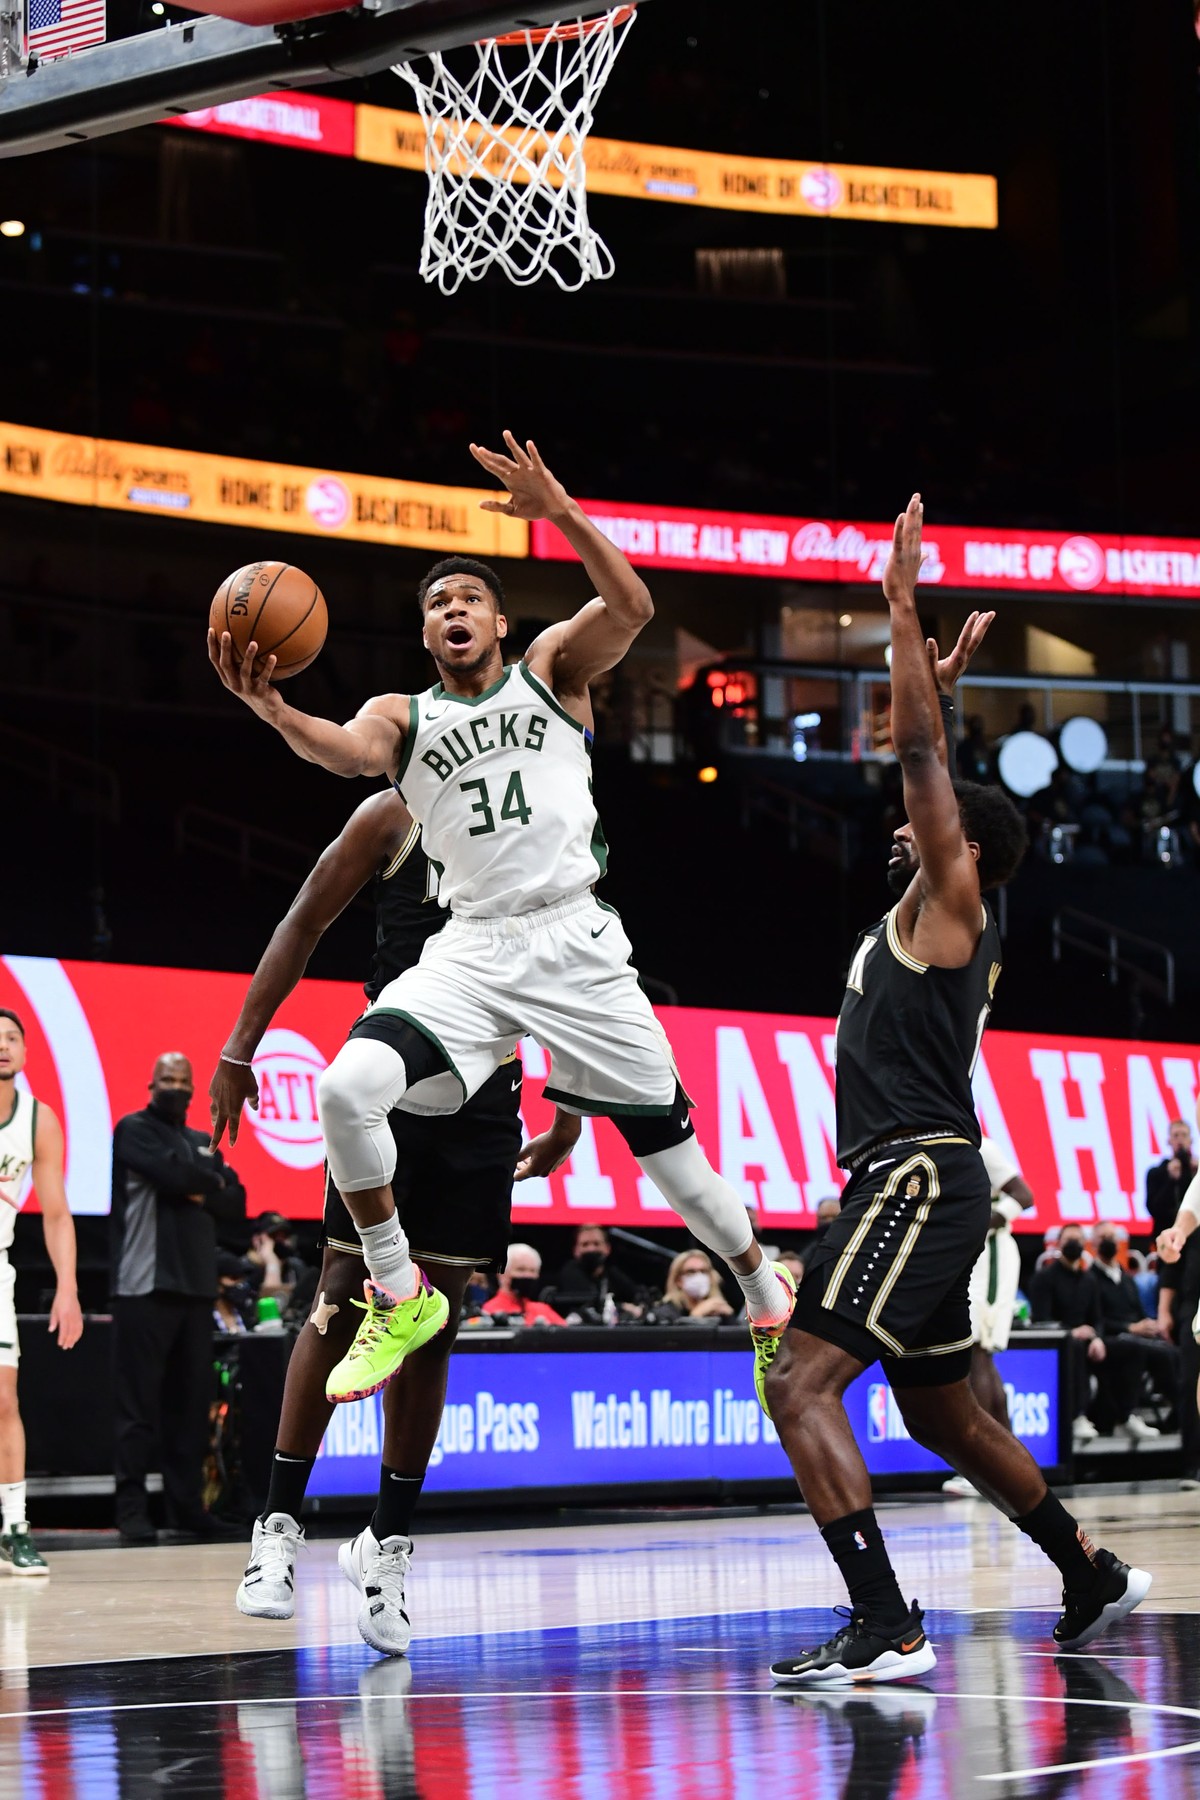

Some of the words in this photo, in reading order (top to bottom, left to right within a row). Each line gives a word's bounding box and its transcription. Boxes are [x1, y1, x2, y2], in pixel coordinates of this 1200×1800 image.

[721, 172, 769, 198] HOME
[847, 182, 954, 213] BASKETBALL
[221, 477, 273, 511] HOME
[282, 483, 301, 513] OF
[355, 494, 469, 535] BASKETBALL
[656, 520, 699, 559] THE
[700, 525, 789, 566] ALL-NEW
[964, 541, 1026, 579] HOME
[1028, 545, 1056, 580] OF
[421, 713, 548, 782] BUCKS
[459, 770, 532, 837] 34
[326, 1396, 379, 1458] NBA
[475, 1391, 540, 1453] Pass
[571, 1389, 648, 1449] Watch
[650, 1389, 710, 1446] More
[713, 1388, 760, 1446] Live
